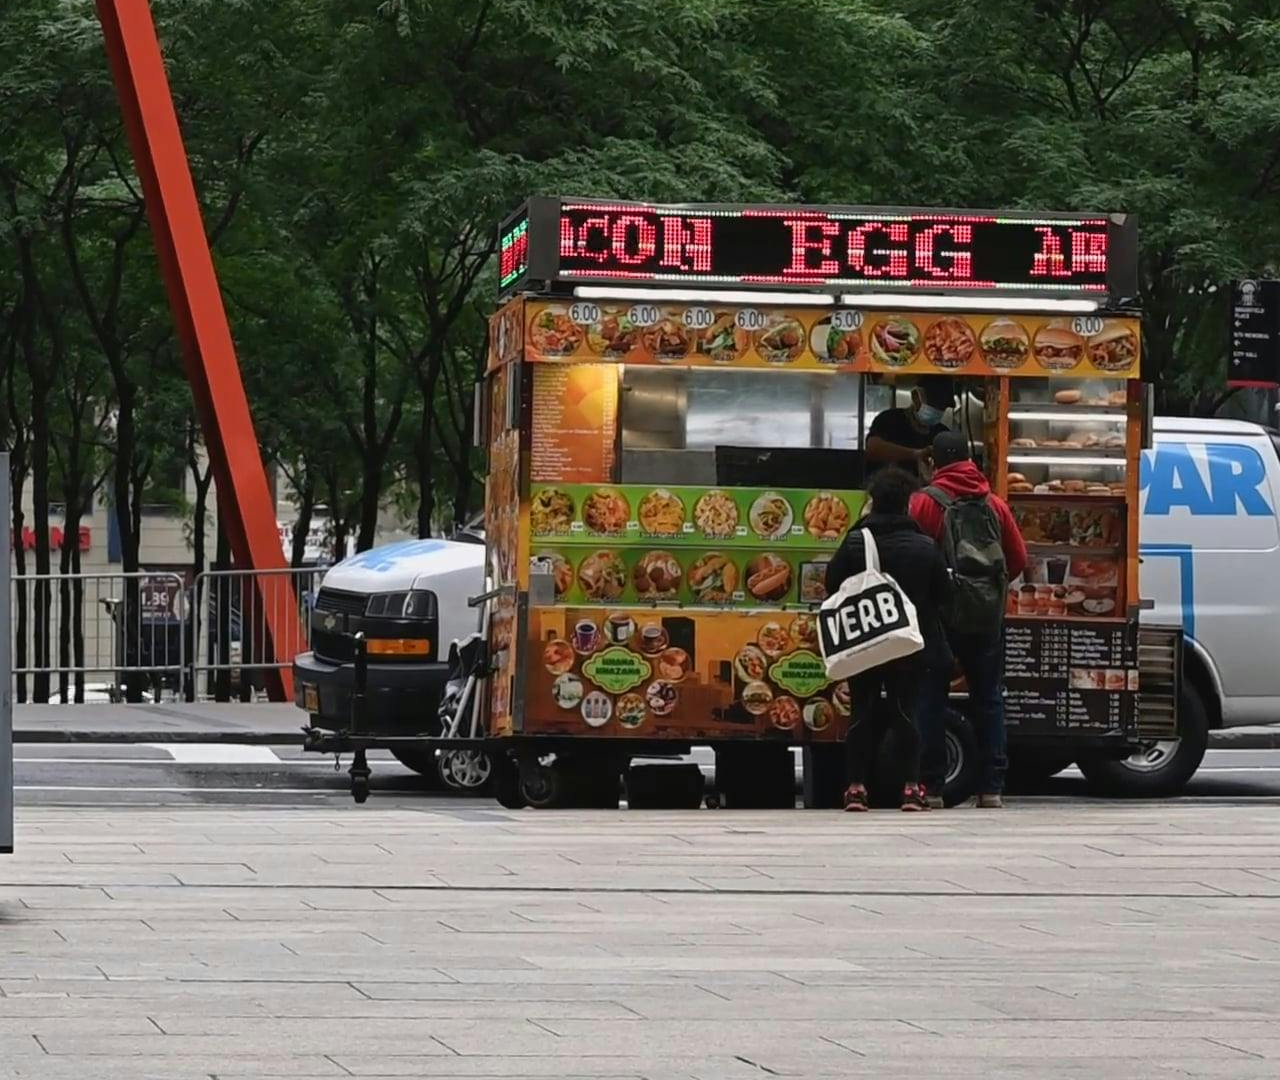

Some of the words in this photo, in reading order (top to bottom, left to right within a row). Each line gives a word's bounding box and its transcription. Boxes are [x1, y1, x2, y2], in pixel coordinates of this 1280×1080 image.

[783, 220, 972, 277] EGG
[571, 306, 598, 322] 6.00
[630, 307, 657, 323] 6.00
[685, 309, 712, 326] 6.00
[738, 311, 765, 328] 6.00
[834, 311, 861, 328] 5.00
[1075, 318, 1101, 334] 6.00
[1140, 442, 1276, 516] AR
[827, 591, 900, 646] VERB
